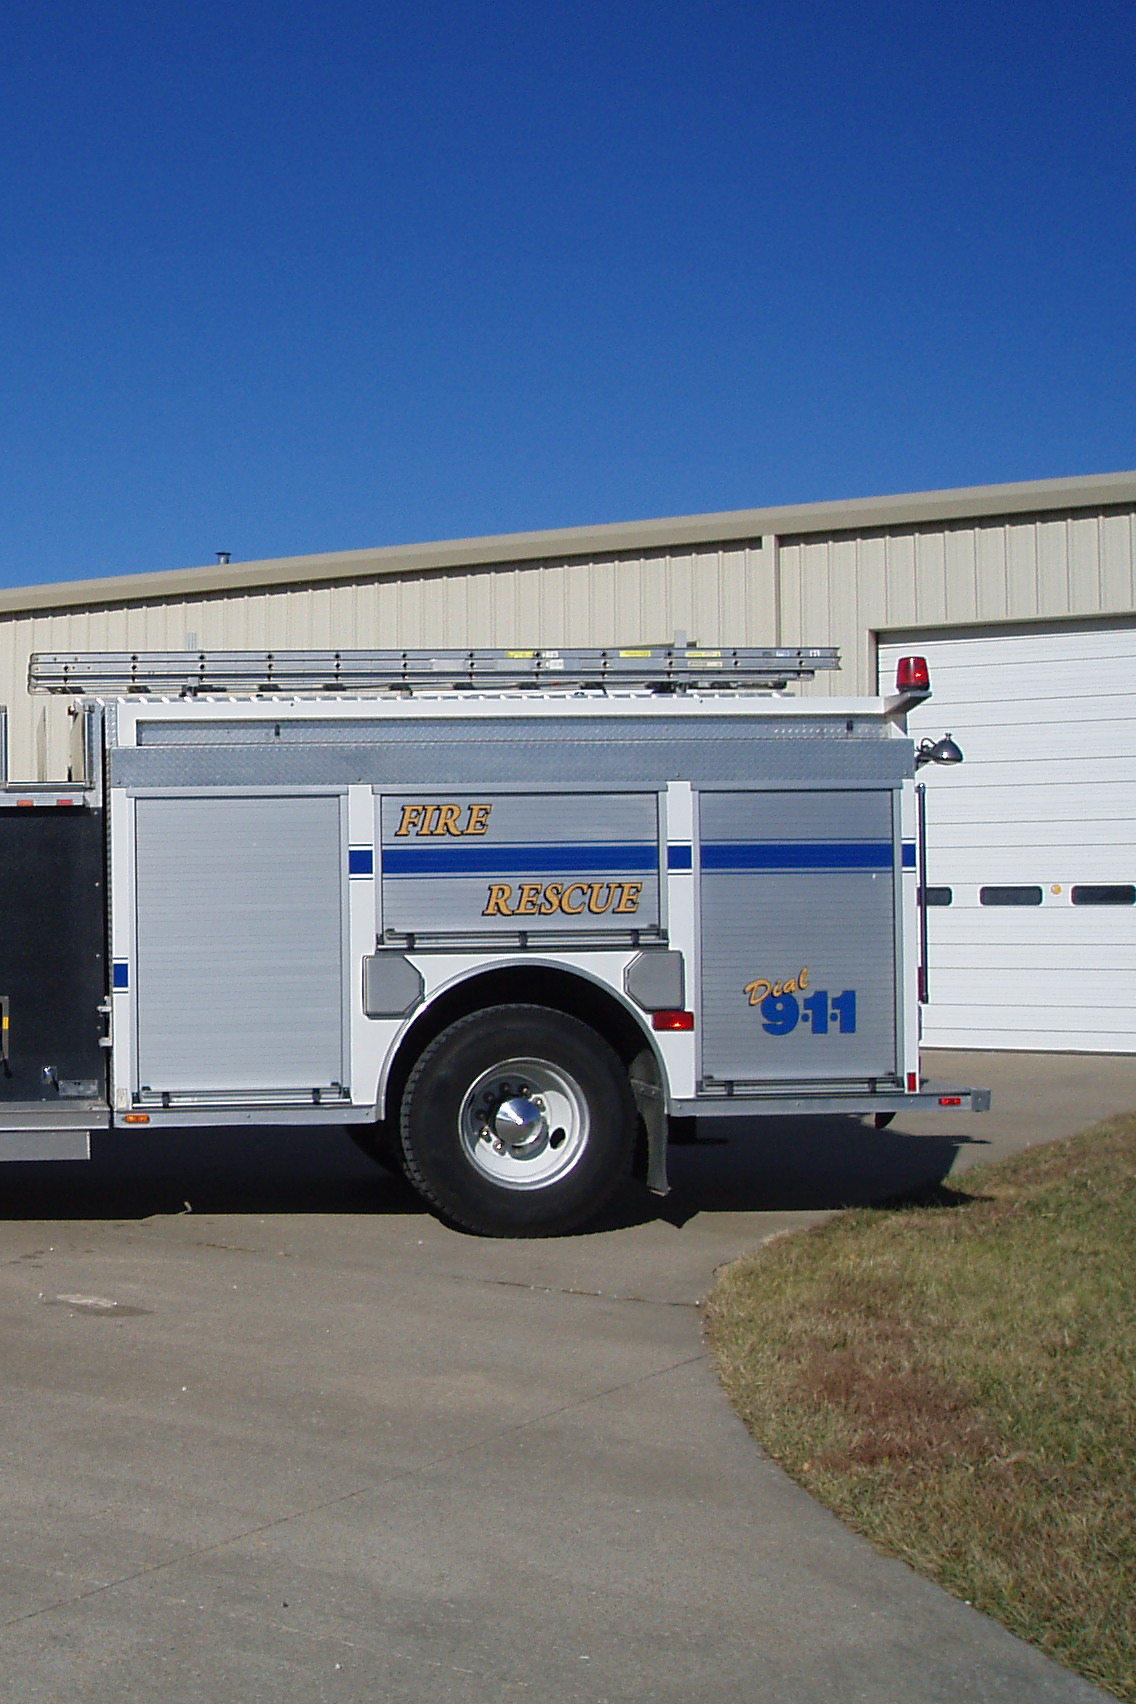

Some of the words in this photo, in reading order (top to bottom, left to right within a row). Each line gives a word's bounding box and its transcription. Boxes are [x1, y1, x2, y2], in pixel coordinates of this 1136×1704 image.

[395, 804, 492, 836] FIRE
[482, 882, 643, 916] RESCUE
[743, 966, 810, 1006] Dial
